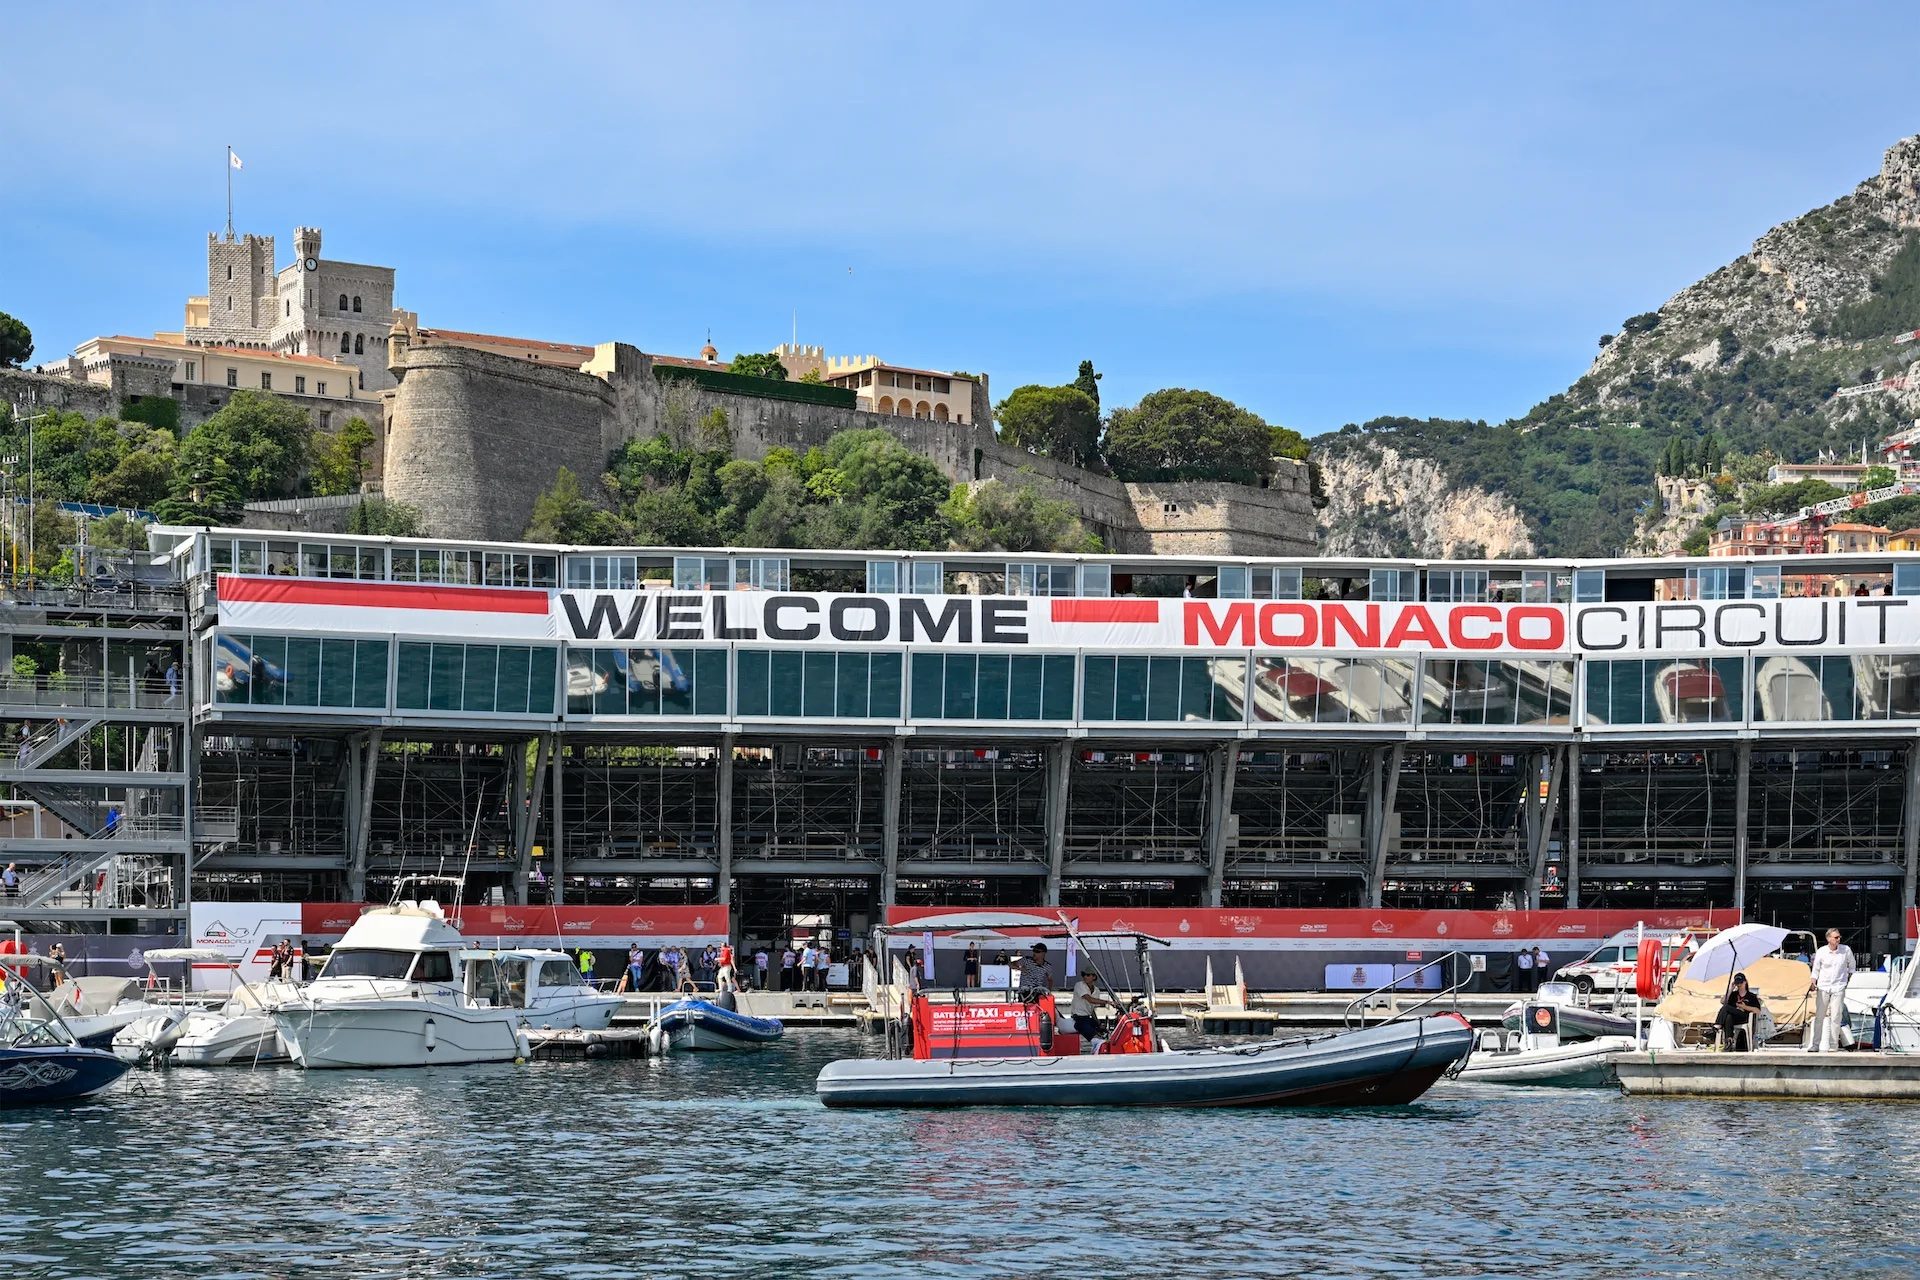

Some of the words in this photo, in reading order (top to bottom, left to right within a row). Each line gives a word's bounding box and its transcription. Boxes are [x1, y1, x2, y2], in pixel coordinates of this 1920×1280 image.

[560, 593, 1029, 643] WELCOME
[1183, 601, 1564, 650] MONACO
[1577, 600, 1908, 650] CIRCUIT
[933, 1011, 966, 1019] BATEAU
[969, 1008, 999, 1017] TAXI
